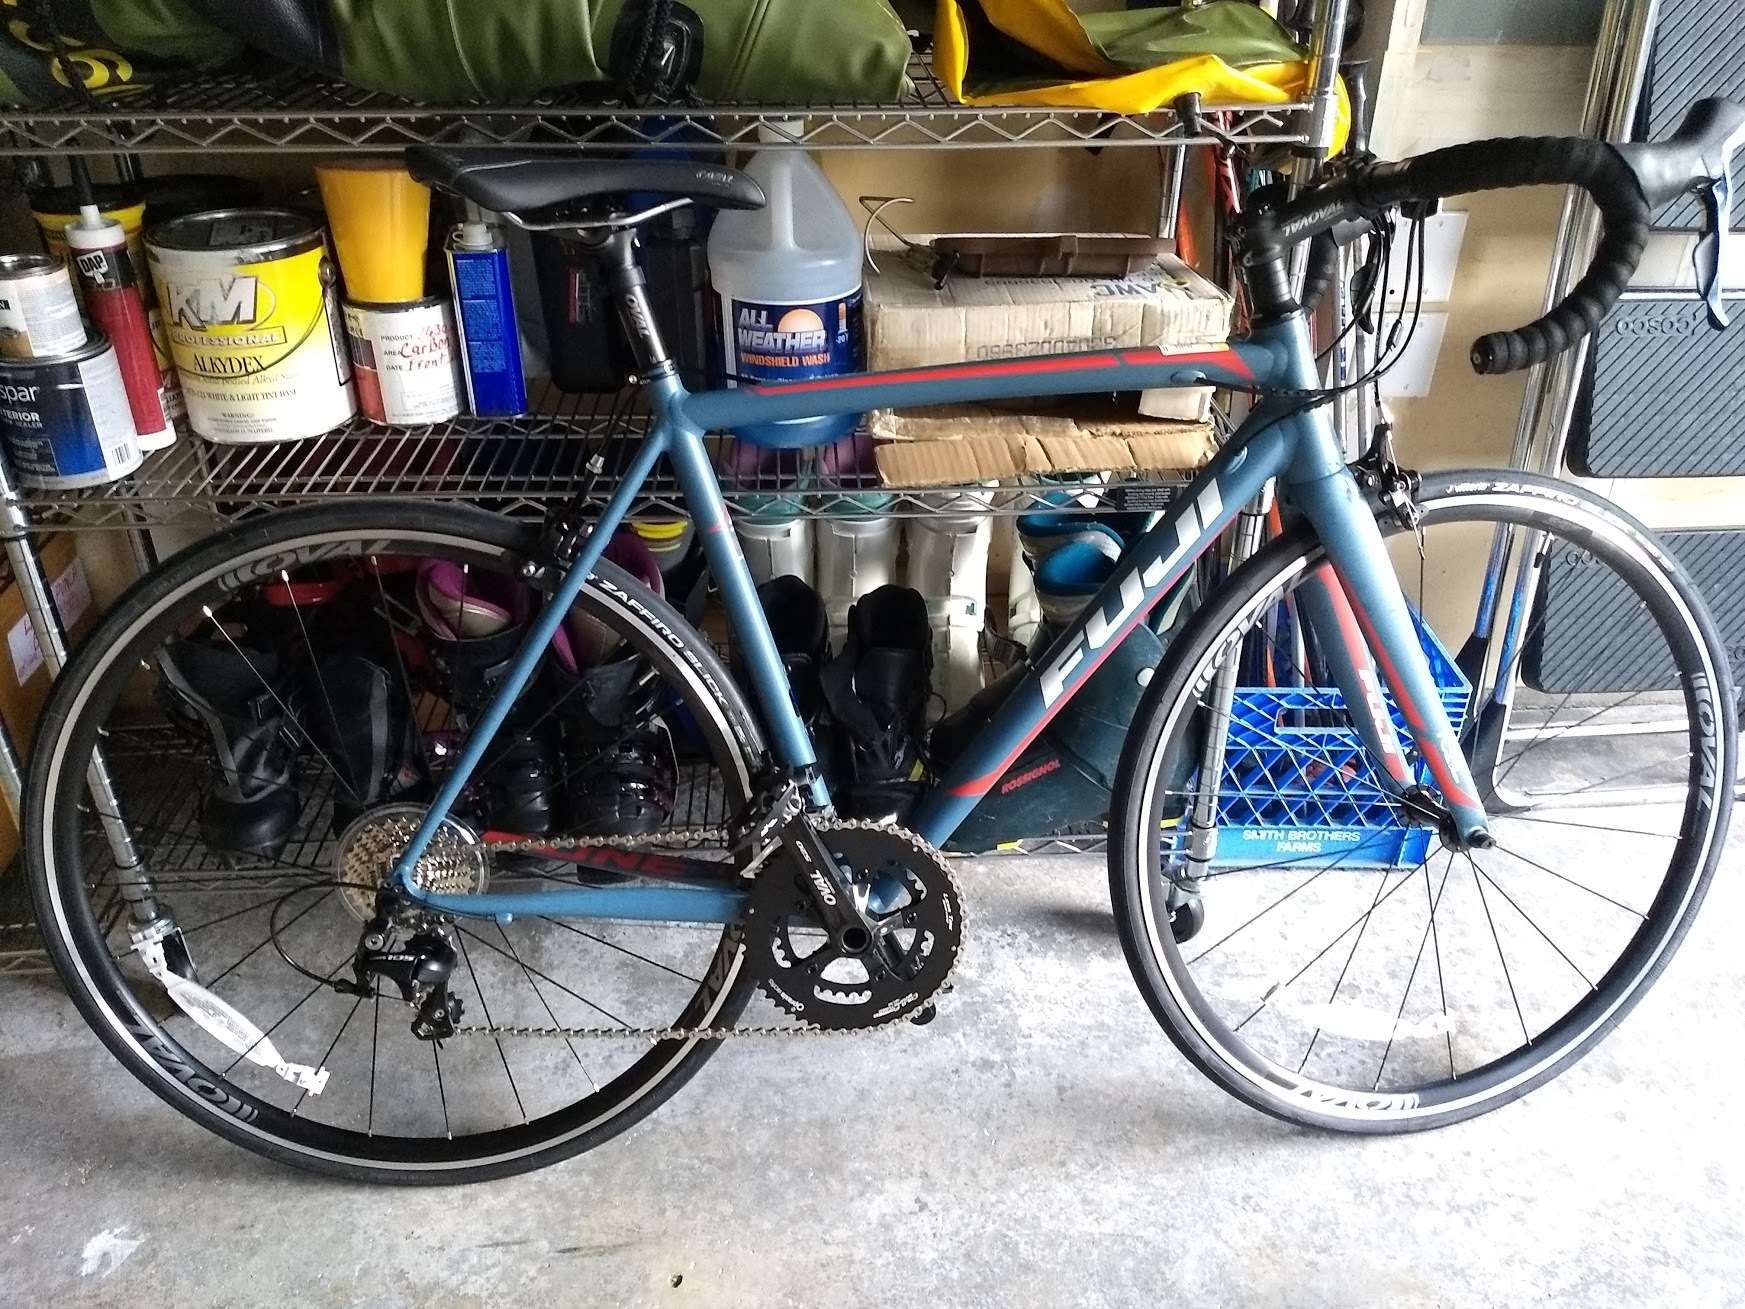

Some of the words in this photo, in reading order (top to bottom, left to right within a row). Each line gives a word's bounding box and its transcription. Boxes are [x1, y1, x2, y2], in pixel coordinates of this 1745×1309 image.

[80, 254, 104, 274] DAP
[625, 293, 650, 339] OVAL
[738, 308, 774, 331] ALL
[173, 330, 280, 347] PROFESSIONAL
[380, 334, 413, 342] PRODUCT
[738, 328, 828, 353] WEATHER
[194, 353, 267, 374] ALKYDEX
[741, 352, 799, 367] WINDSHIELD
[801, 353, 830, 367] WASH
[253, 538, 396, 577] OVAL
[1040, 477, 1224, 709] FUJI
[599, 579, 685, 649] ZAFFIRO
[683, 649, 729, 707] SLICK
[1695, 700, 1717, 813] OVAL
[1001, 759, 1061, 795] ROSSIGNOL
[1242, 829, 1286, 841] SMITH
[1287, 829, 1361, 842] BROTHERS
[1276, 841, 1322, 853] FARMS
[808, 869, 837, 907] OVAL
[115, 989, 229, 1104] OVAL
